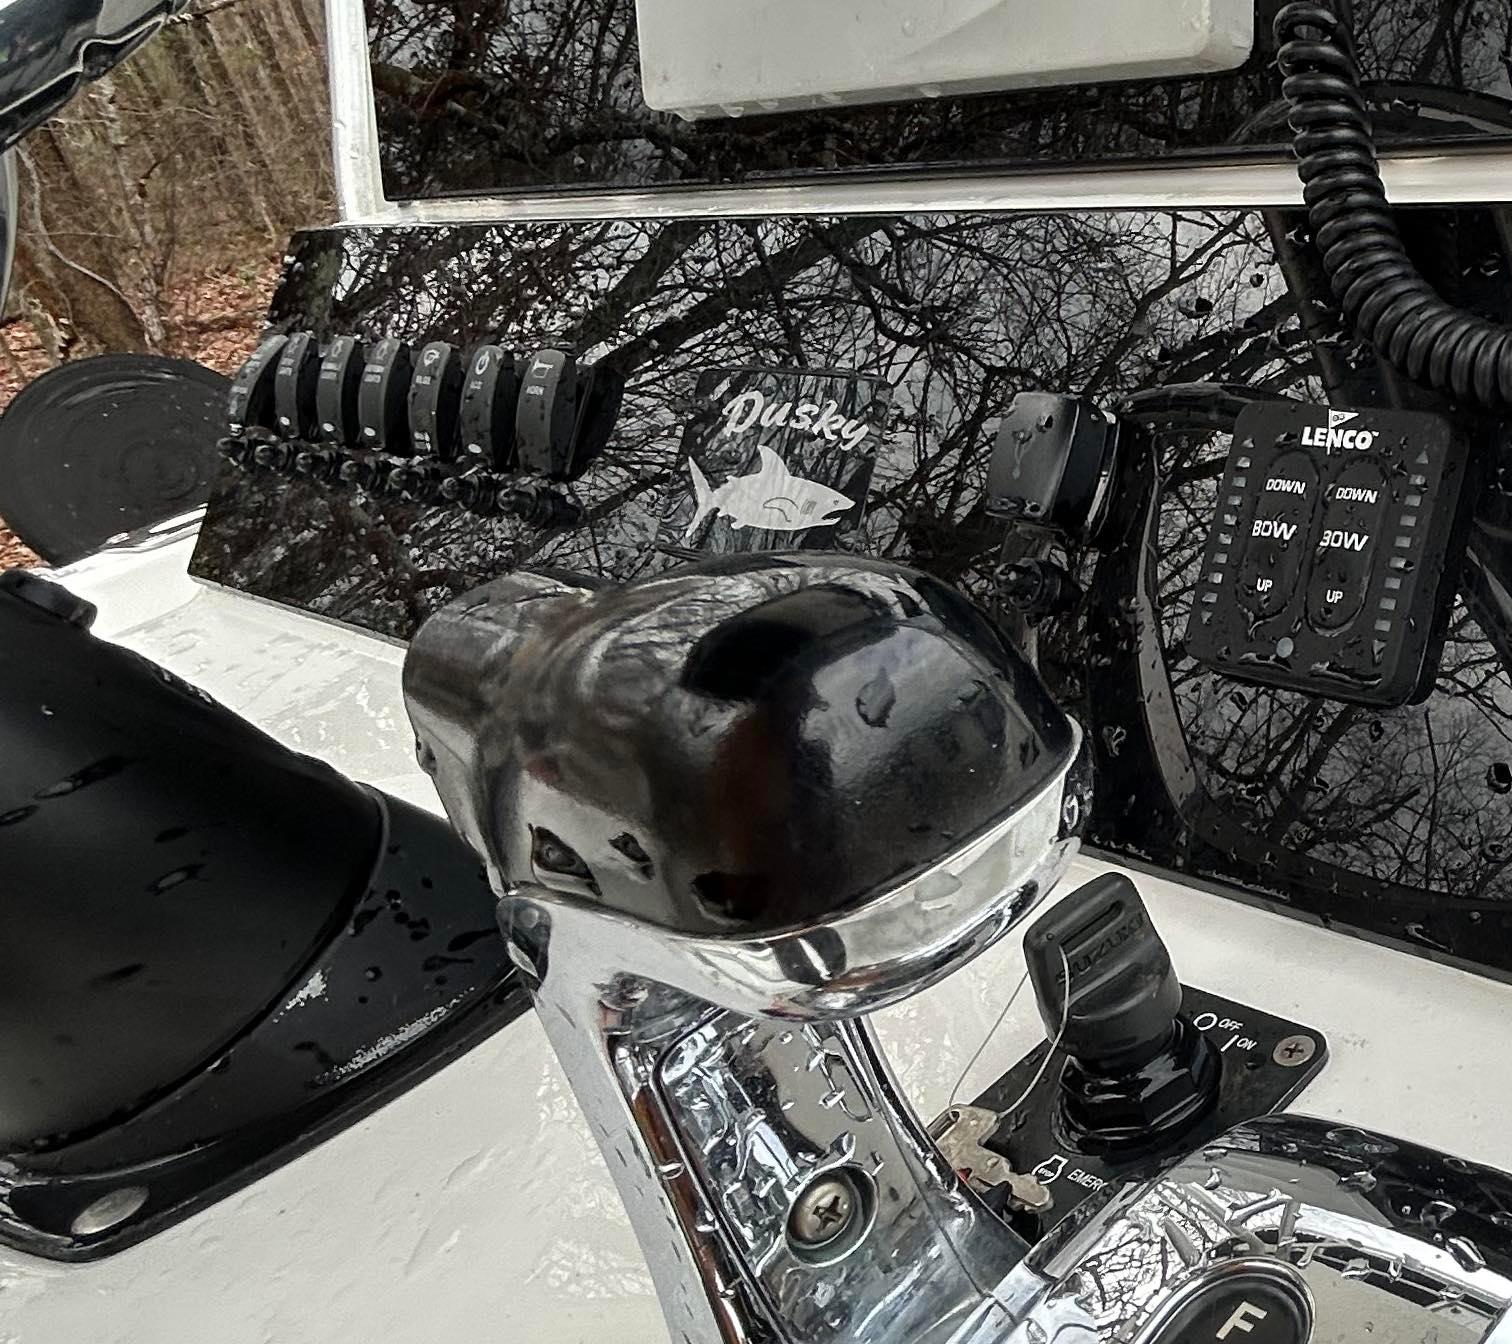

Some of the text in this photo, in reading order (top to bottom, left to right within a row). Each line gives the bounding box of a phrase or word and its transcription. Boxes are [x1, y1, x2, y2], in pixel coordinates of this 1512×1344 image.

[721, 390, 869, 451] Dusky
[1301, 426, 1374, 450] LENCO
[1265, 478, 1307, 495] DOWN
[1335, 487, 1379, 504] DOWN
[1256, 577, 1273, 593] UP
[1325, 589, 1344, 604] UP
[1218, 1018, 1244, 1032] OFF
[1236, 1037, 1258, 1051] ON
[1216, 1301, 1268, 1340] F
